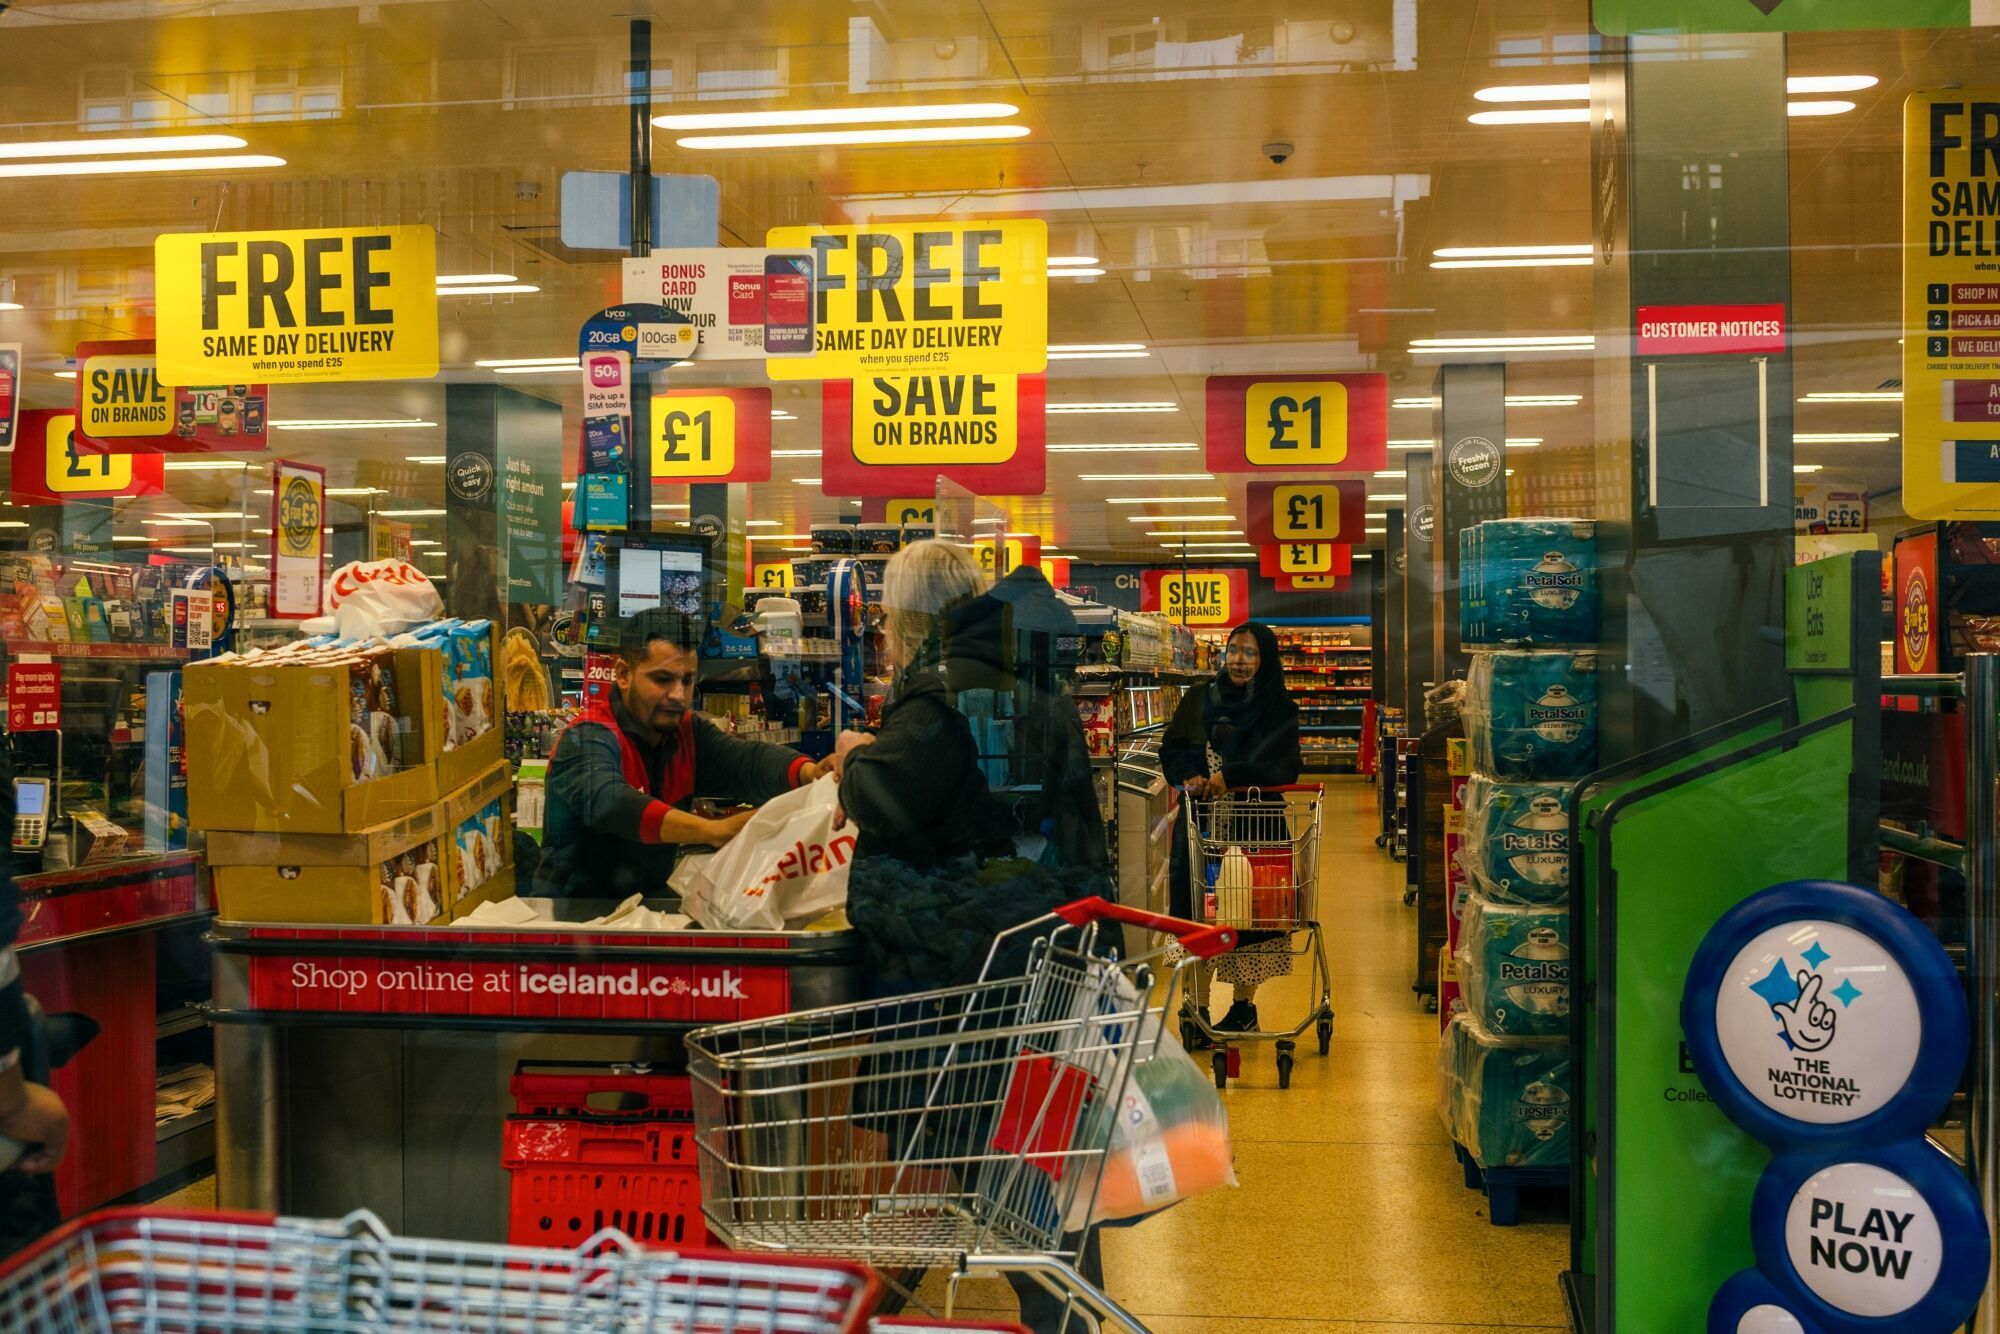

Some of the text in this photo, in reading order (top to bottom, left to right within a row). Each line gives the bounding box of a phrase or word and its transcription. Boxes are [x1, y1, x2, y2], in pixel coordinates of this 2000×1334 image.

[662, 264, 706, 279] BONUS
[811, 230, 1003, 324] FREE
[201, 235, 394, 330] FREE
[662, 281, 696, 296] CARD
[733, 282, 761, 291] Bonus
[733, 290, 754, 299] Card
[1934, 287, 1998, 300] 1 SHOP IN
[662, 297, 692, 312] NOW
[605, 309, 626, 319] Lyca
[1934, 314, 1942, 326] 2
[1957, 315, 1982, 327] PICK
[1984, 314, 1991, 326] A
[589, 331, 620, 343] 20GB
[871, 328, 907, 349] DAY
[913, 325, 1003, 349] DELIVERY
[1641, 320, 1780, 339] CUSTOMER NOTICES
[203, 331, 394, 357] SAME DAY DELIVERY
[641, 332, 677, 344] 100GB
[1934, 341, 1942, 352] 3
[1957, 341, 1975, 353] WE
[253, 360, 276, 370] when
[279, 360, 295, 371] you
[297, 358, 324, 371] spend
[860, 354, 884, 364] when
[886, 355, 901, 366] you
[904, 352, 931, 365] spend
[594, 365, 619, 379] 50p
[589, 393, 606, 401] Pick
[607, 393, 617, 401] up
[872, 374, 997, 418] SAVE
[587, 400, 627, 410] SIM today
[91, 406, 166, 423] ON BRANDS
[1267, 396, 1322, 450] £1
[662, 410, 711, 462] £1
[873, 420, 998, 446] ON BRANDS
[506, 456, 531, 476] Just the
[1457, 452, 1490, 466] Freshly
[457, 464, 482, 477] Quick
[1461, 461, 1490, 474] frozen
[462, 477, 481, 488] easy
[506, 475, 544, 497] right amount
[1287, 494, 1323, 530] £1
[1827, 509, 1861, 528] £££
[763, 569, 785, 588] £1
[1526, 574, 1584, 587] PetalSoft
[1168, 581, 1221, 605] SAVE
[1169, 606, 1222, 617] ON BRANDS
[1530, 708, 1585, 719] PetalSoft
[291, 962, 368, 995] Shop
[376, 965, 474, 992] online
[482, 969, 511, 993] at
[1794, 1057, 1830, 1075] THE
[1768, 1068, 1861, 1093] NATIONAL
[1809, 1198, 1915, 1244] PLAY
[1809, 1236, 1913, 1280] NOW
